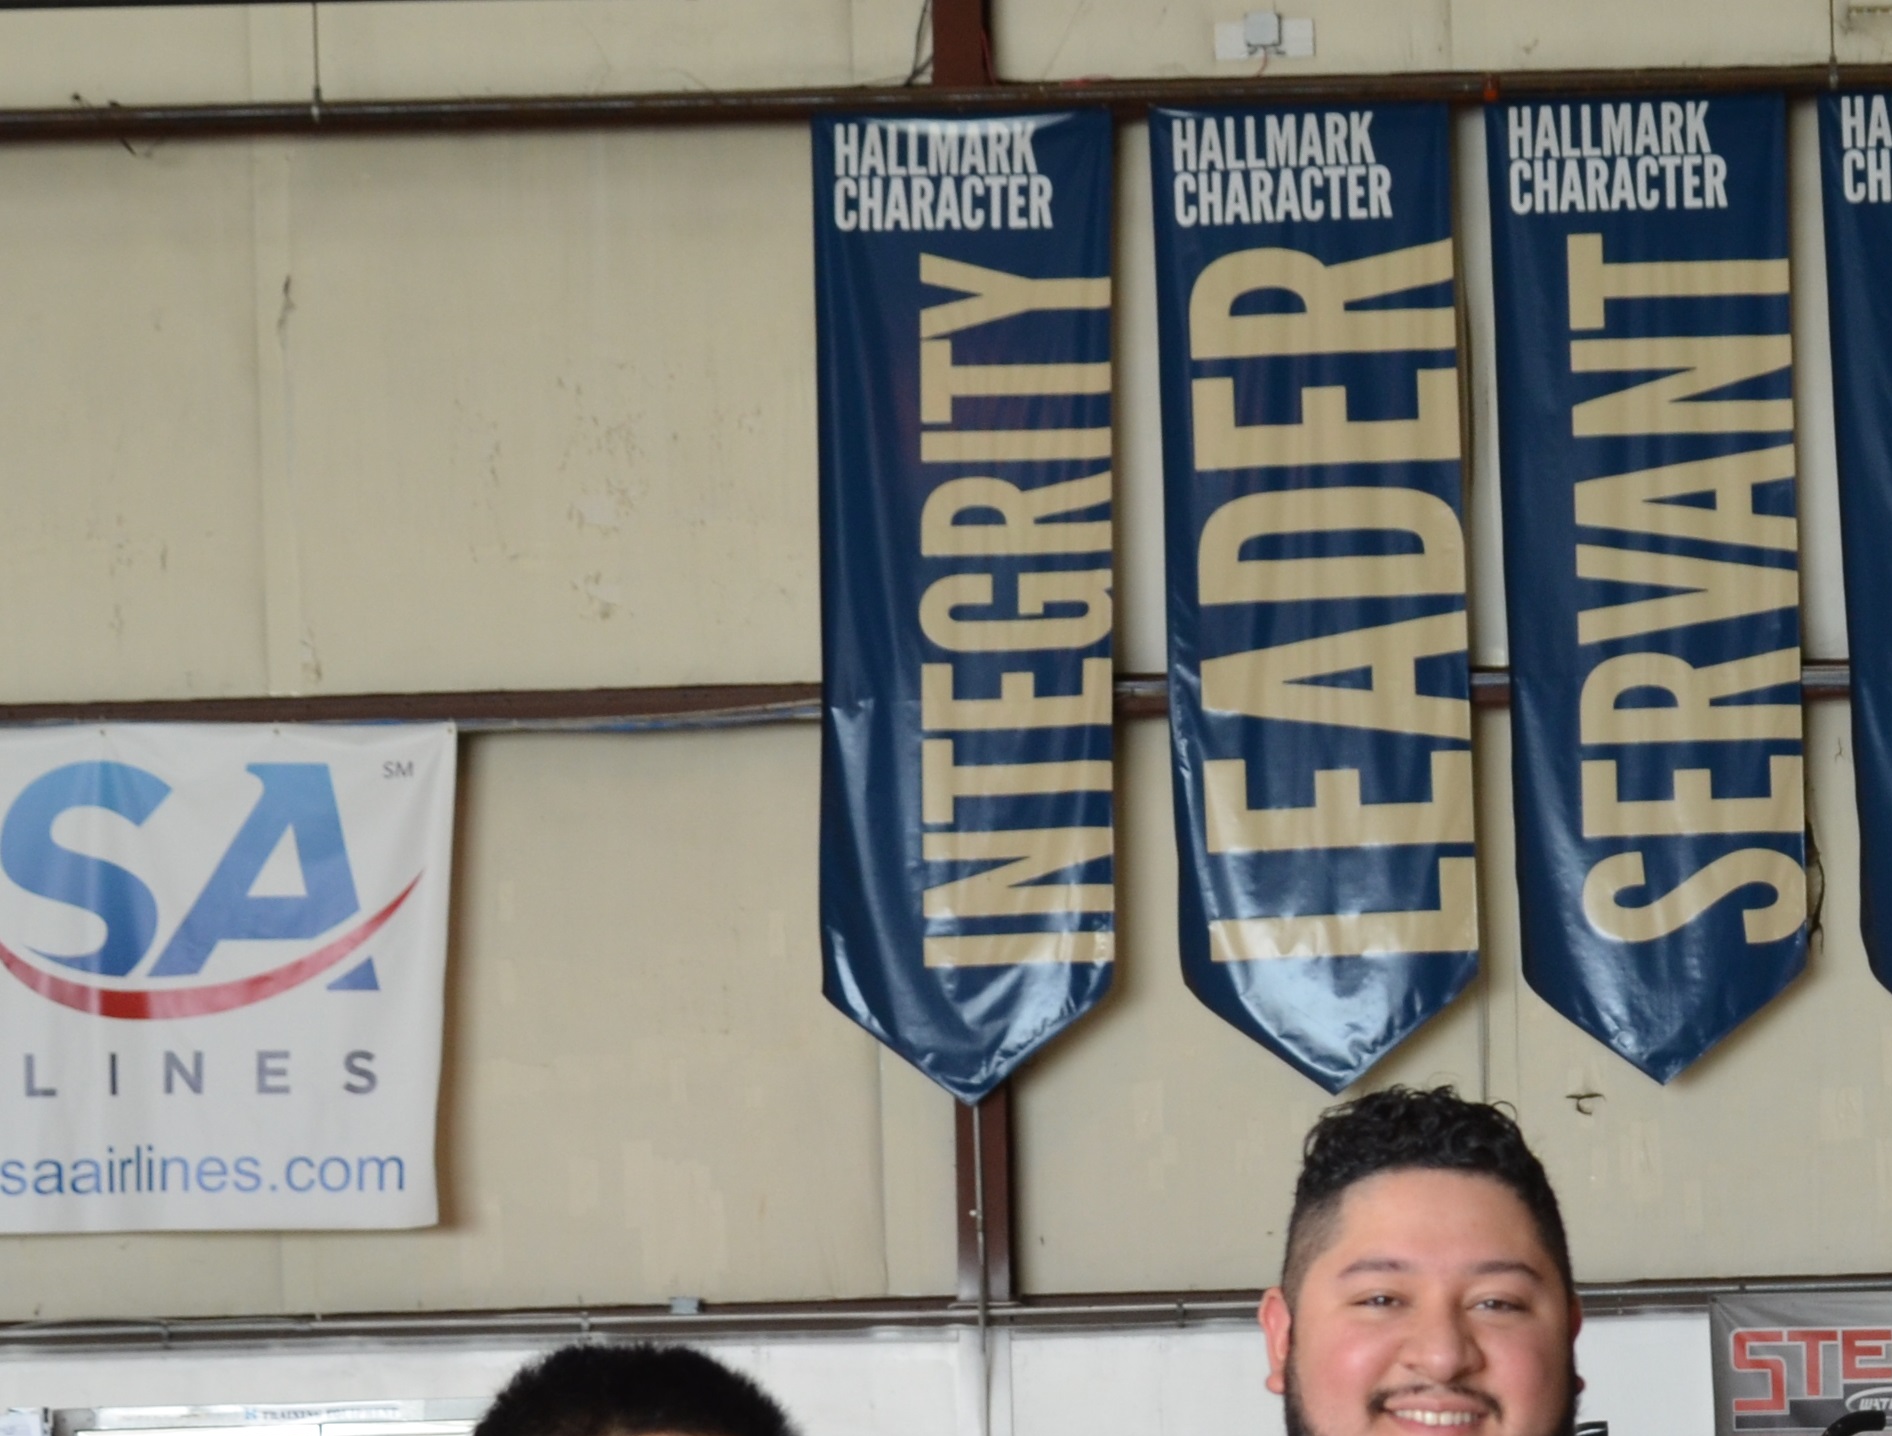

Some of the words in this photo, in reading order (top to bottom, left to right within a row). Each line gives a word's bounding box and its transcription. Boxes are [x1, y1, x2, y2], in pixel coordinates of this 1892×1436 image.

[834, 122, 1039, 178] HALLMARK
[1172, 111, 1376, 172] HALLMARK
[1507, 101, 1712, 159] HALLMARK
[834, 174, 1052, 232] CHARACTER
[1173, 163, 1393, 228] CHARACTER
[1508, 154, 1729, 216] CHARACTER
[919, 253, 1114, 968] INTEGRITY
[1189, 237, 1480, 963] LEADER
[1566, 233, 1807, 944] SERVANT
